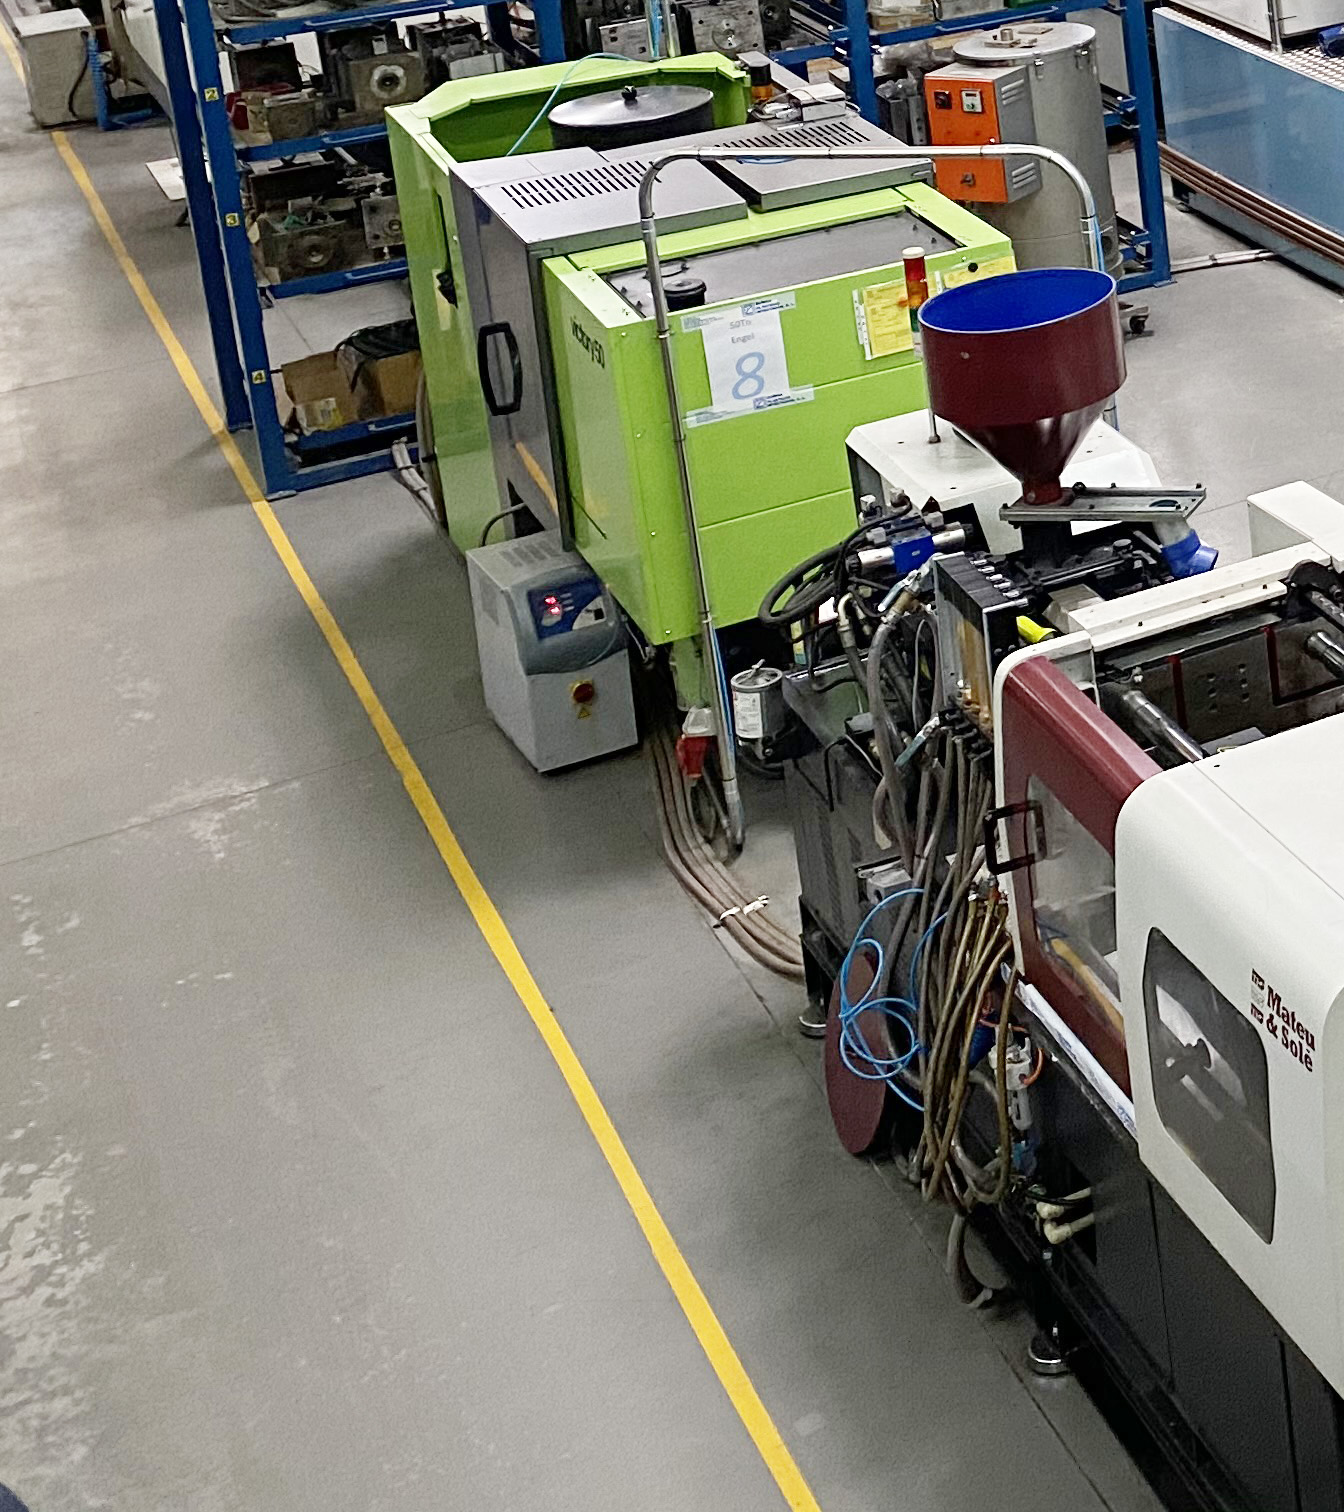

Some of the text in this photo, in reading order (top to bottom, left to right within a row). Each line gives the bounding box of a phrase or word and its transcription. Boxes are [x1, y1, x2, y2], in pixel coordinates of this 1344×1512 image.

[731, 332, 755, 344] Engel
[731, 351, 765, 400] 8
[1266, 1012, 1278, 1040] &
[1267, 984, 1316, 1052] Mateu
